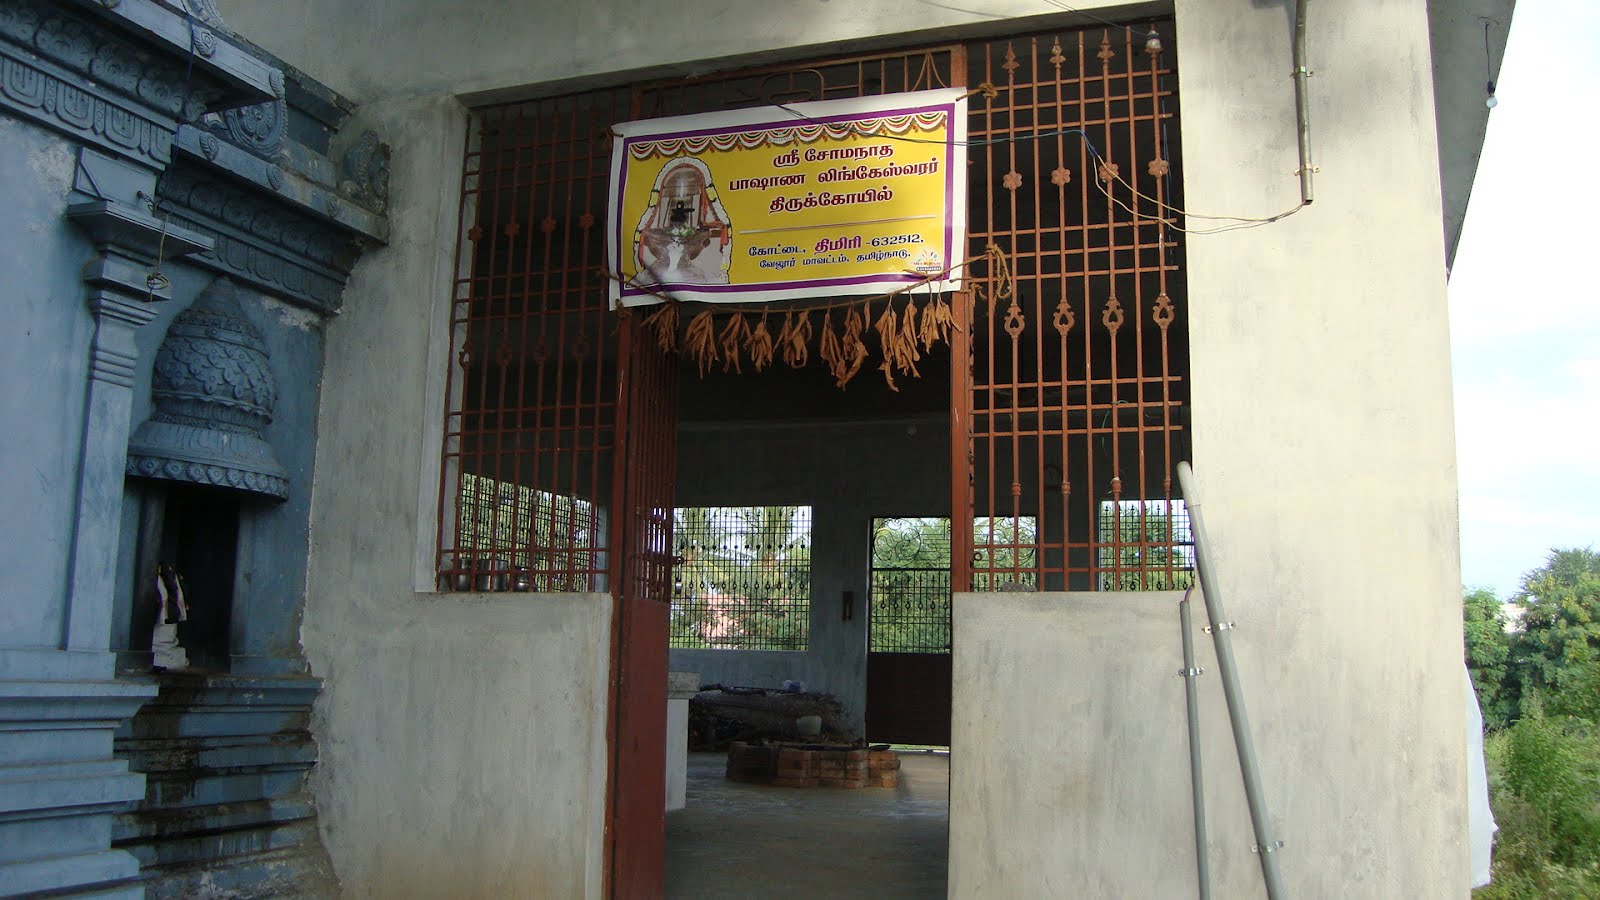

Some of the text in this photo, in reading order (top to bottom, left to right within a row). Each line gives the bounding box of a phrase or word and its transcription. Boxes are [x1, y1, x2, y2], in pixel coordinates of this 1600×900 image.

[804, 144, 894, 162] சோமநாத
[729, 173, 806, 191] பாஷாண
[769, 185, 893, 215] திருக்கோயில்
[759, 257, 797, 270] வேலூர்
